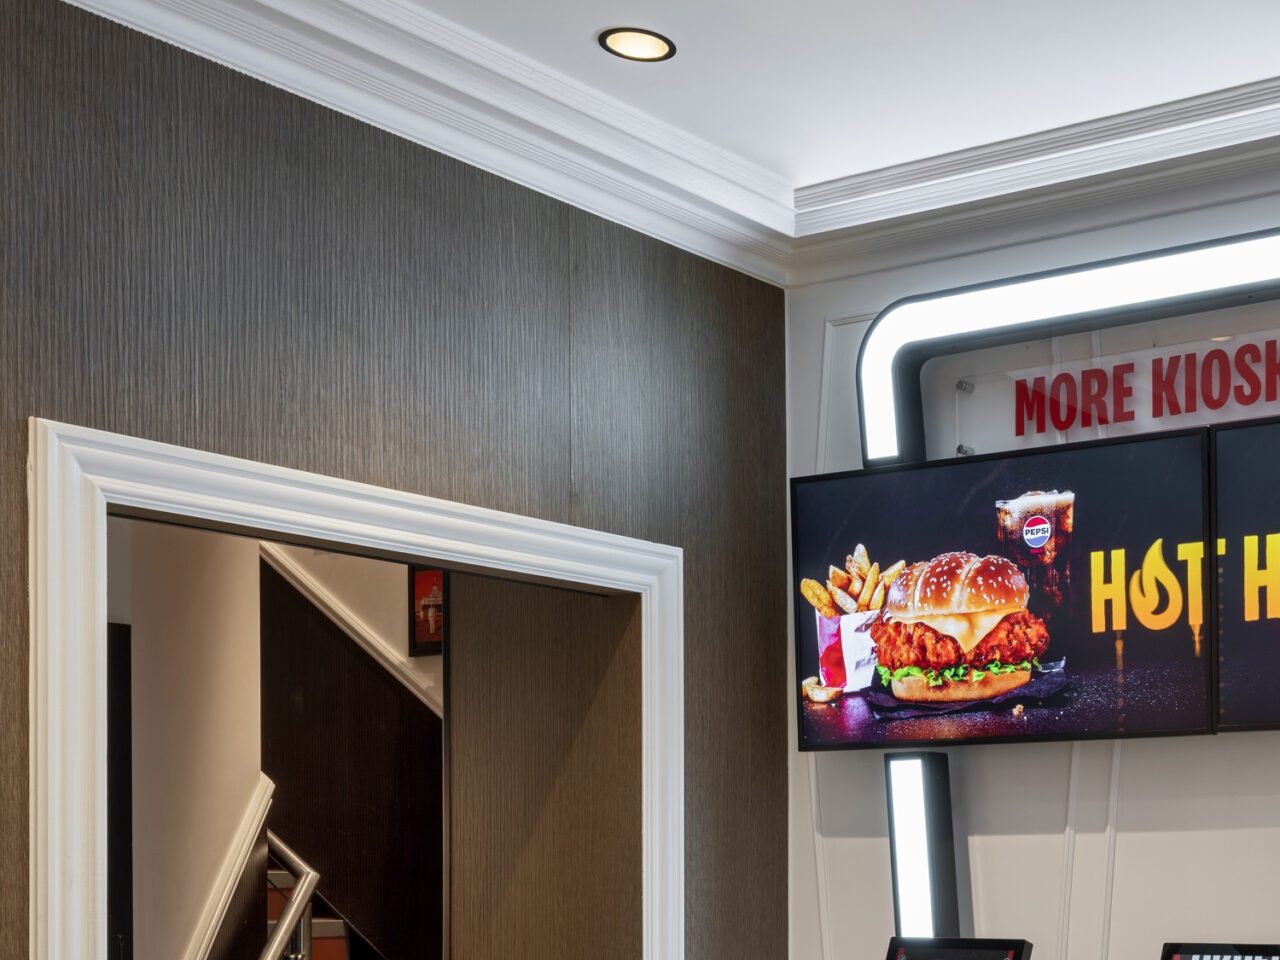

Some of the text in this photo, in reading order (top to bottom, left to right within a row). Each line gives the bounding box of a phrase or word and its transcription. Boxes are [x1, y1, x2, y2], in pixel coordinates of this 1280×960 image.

[1015, 362, 1135, 436] MORE
[1025, 527, 1048, 536] PEPSI
[1090, 538, 1226, 633] HOT
